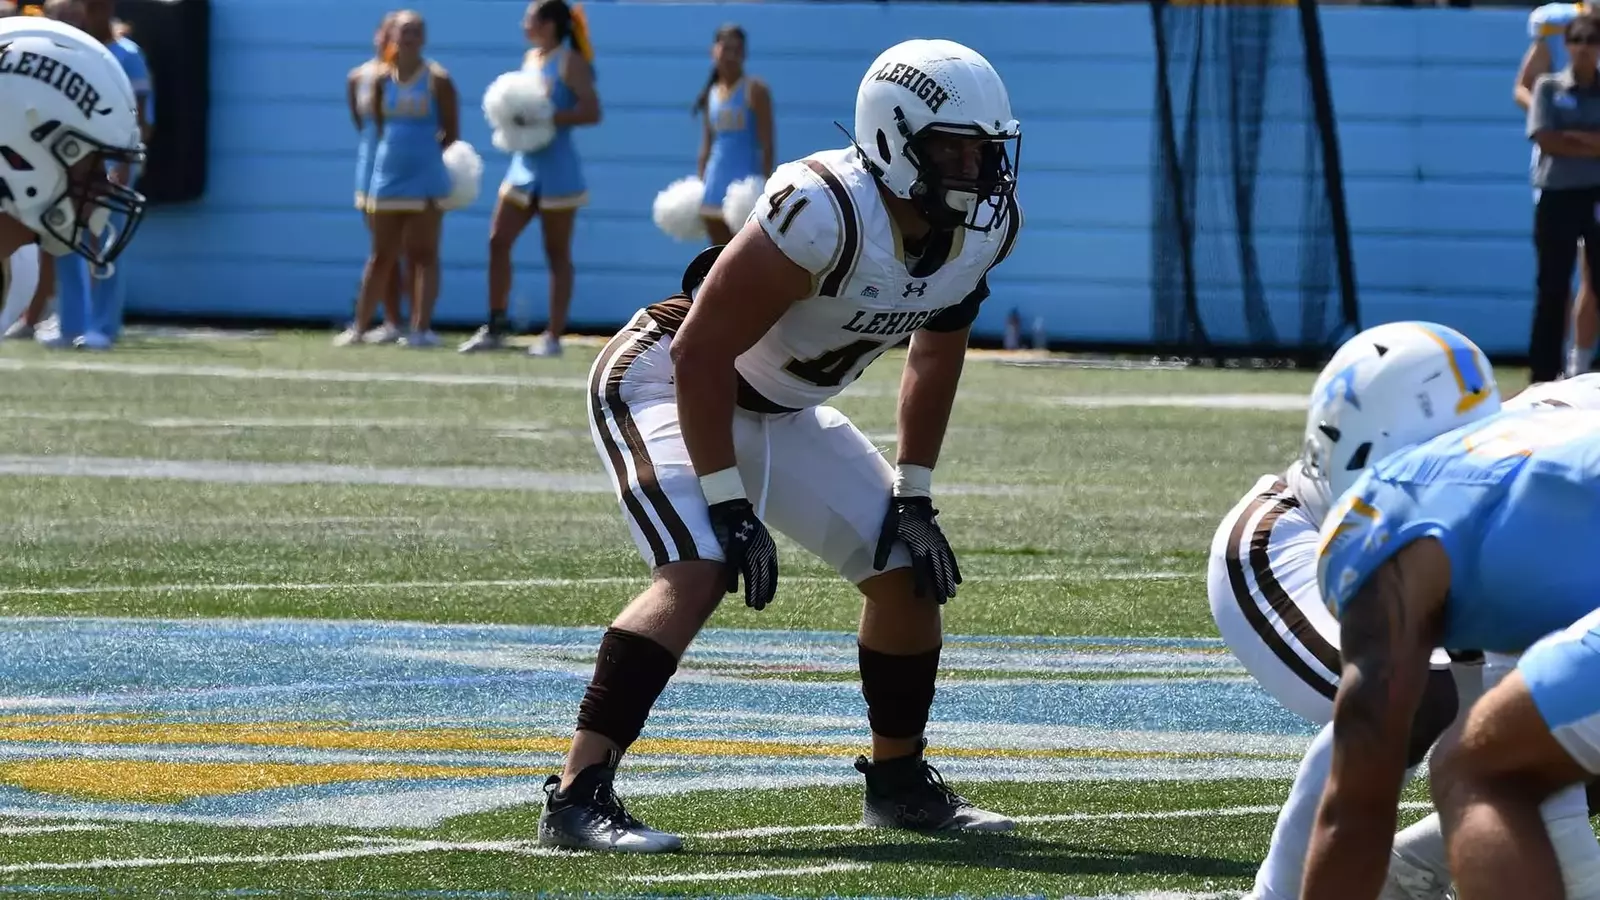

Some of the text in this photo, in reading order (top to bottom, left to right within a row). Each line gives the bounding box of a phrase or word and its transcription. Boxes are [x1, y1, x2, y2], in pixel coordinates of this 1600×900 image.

[0, 50, 101, 119] LEHIGH
[875, 62, 948, 115] LEHIGH
[766, 183, 809, 235] 41
[785, 338, 884, 387] 4
